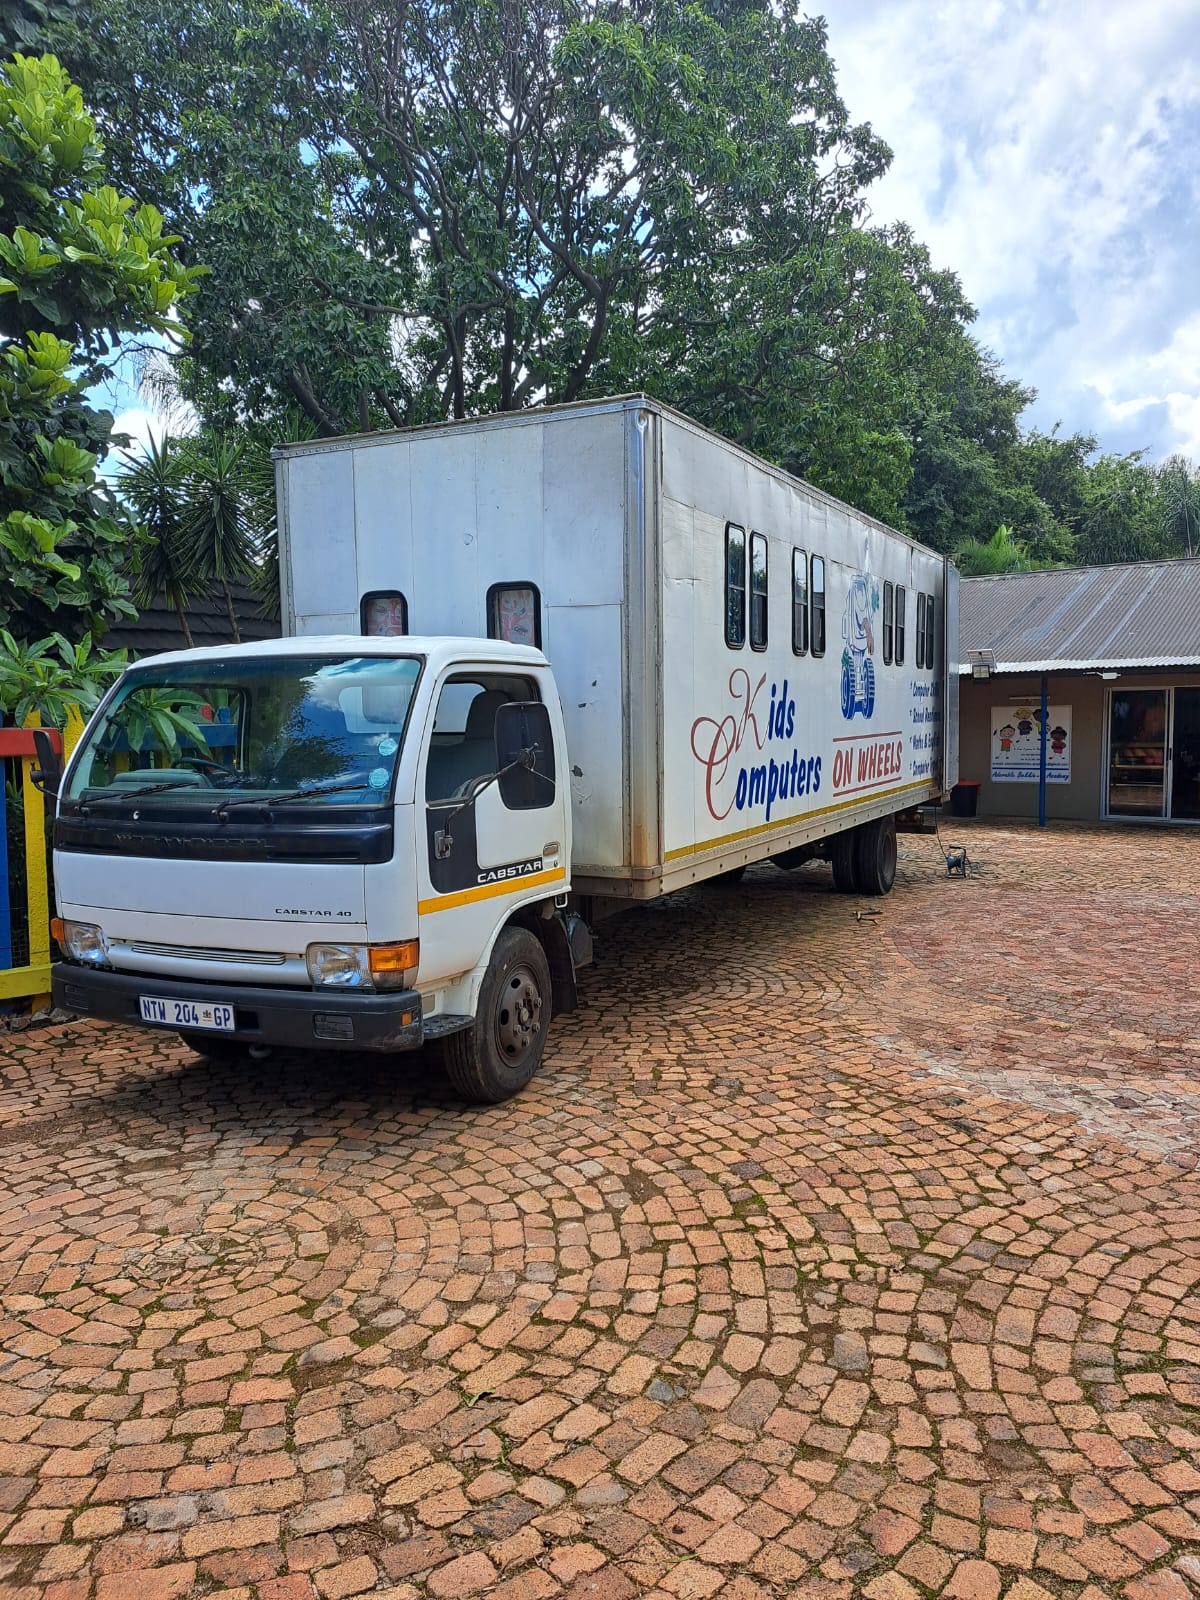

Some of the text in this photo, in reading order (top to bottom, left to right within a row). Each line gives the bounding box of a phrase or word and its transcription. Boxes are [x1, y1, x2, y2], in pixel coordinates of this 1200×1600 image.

[729, 668, 795, 752] Kids
[690, 715, 821, 822] Computers
[832, 749, 853, 789] ON
[857, 740, 903, 783] WHEELS
[477, 860, 542, 883] CABSTAR
[275, 908, 332, 917] CABSTAR
[143, 1000, 231, 1027] NTW 204 GP
